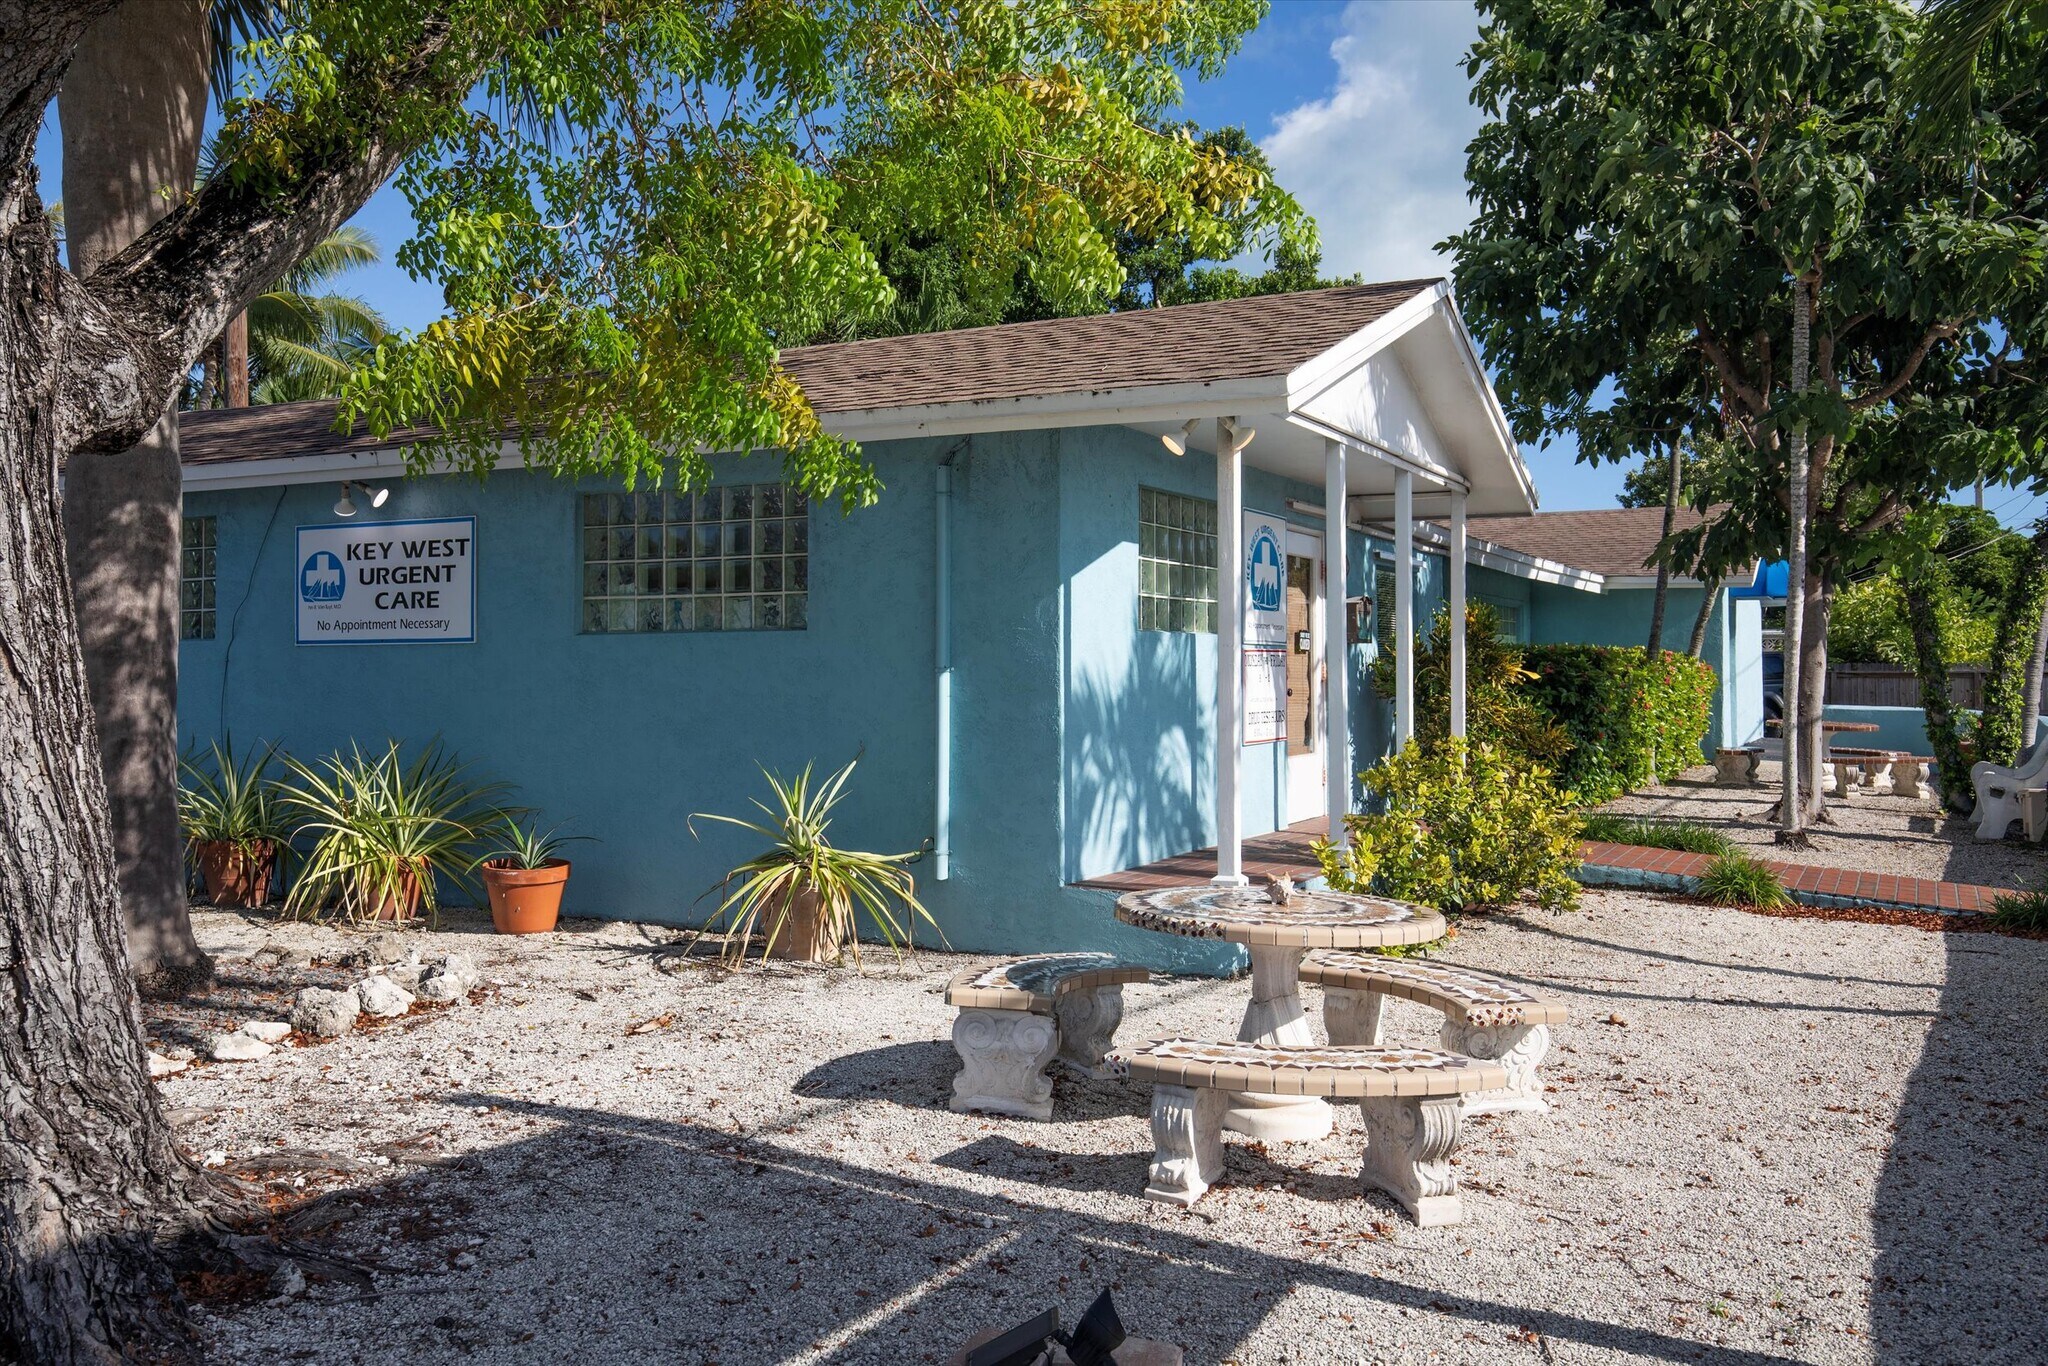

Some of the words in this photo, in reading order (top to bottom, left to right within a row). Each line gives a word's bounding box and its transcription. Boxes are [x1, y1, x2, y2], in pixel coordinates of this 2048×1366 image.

[347, 542, 394, 561] KEY
[401, 538, 470, 559] WEST
[359, 565, 456, 585] URGENT
[374, 590, 440, 610] CARE
[317, 620, 331, 631] No
[333, 619, 397, 633] Appointment
[399, 618, 450, 631] Necessary
